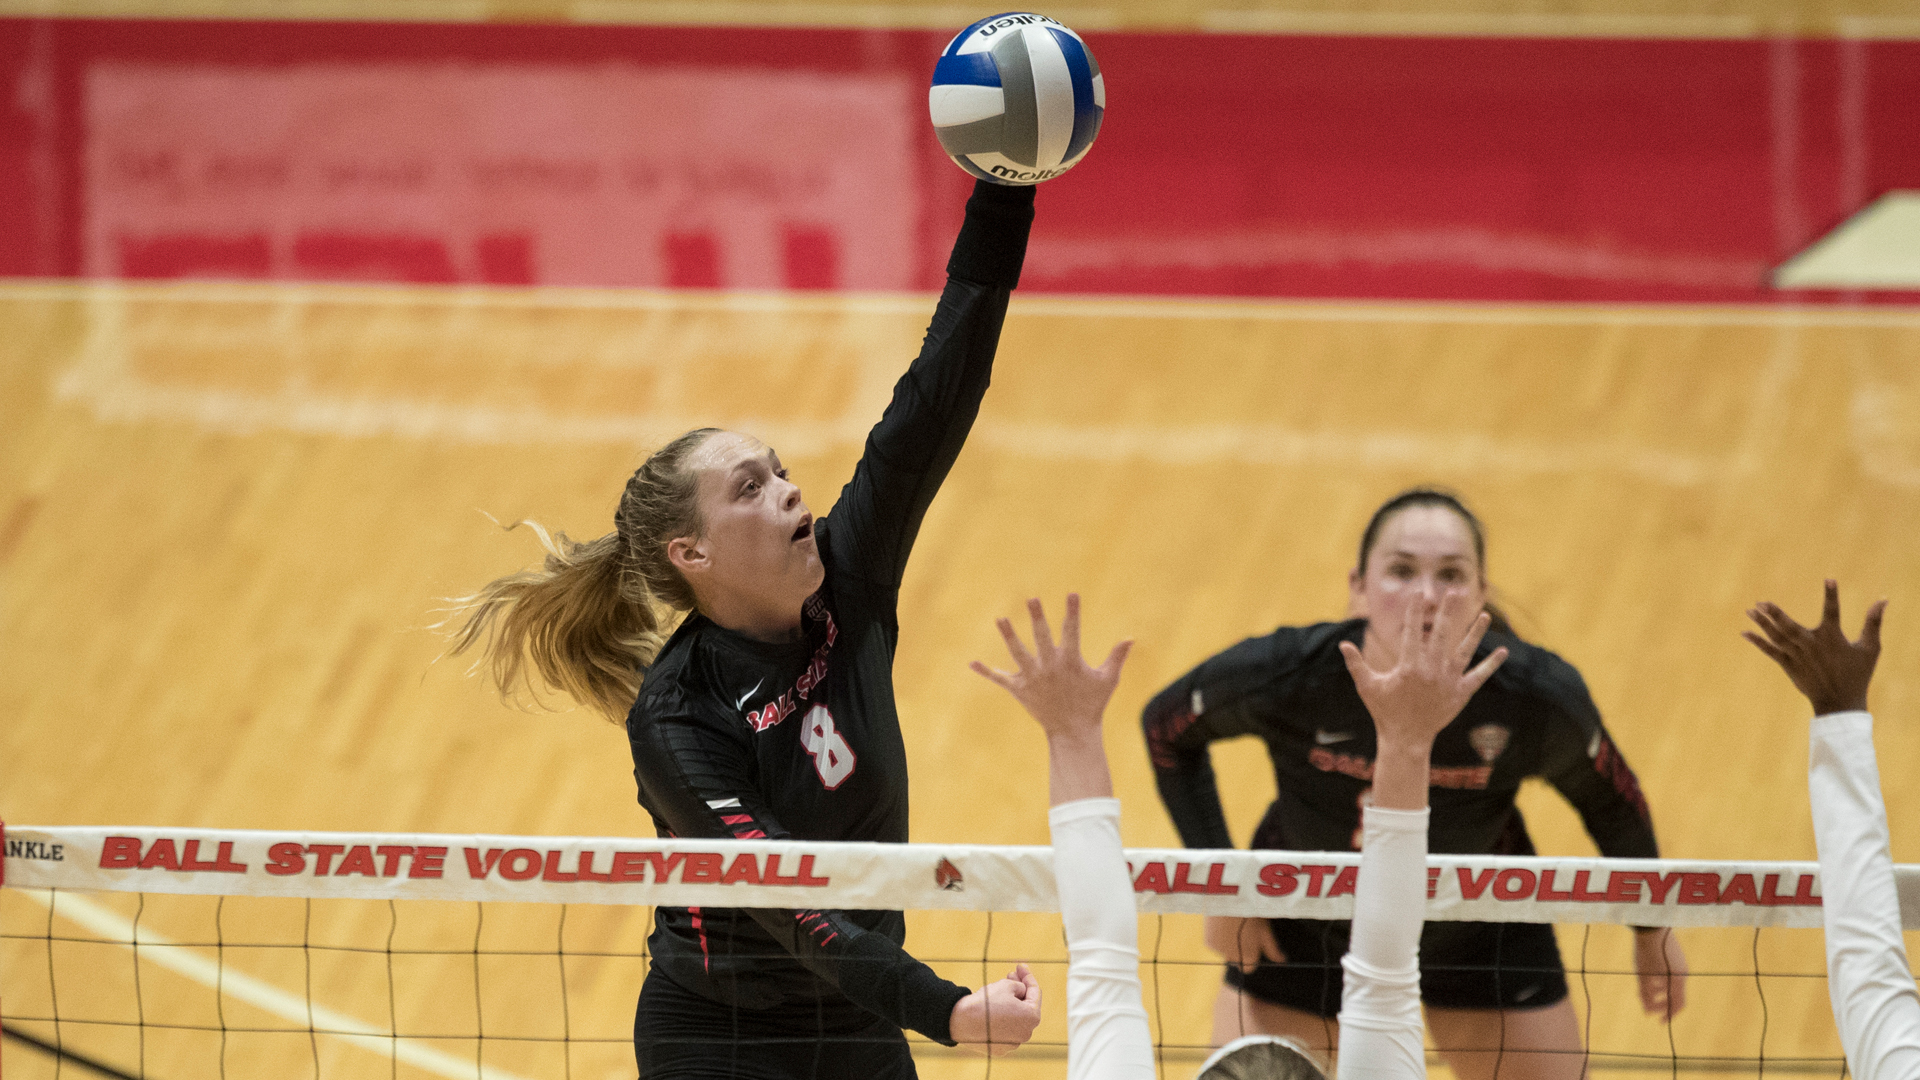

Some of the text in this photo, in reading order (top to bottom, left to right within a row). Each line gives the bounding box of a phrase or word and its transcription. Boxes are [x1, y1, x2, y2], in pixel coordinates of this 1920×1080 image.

[746, 687, 797, 733] BALL
[796, 610, 839, 700] STAE
[800, 702, 857, 791] 8
[99, 836, 830, 887] BALL STATE VOLLEYBALL
[1127, 861, 1823, 907] ALL STA VOLLEYBALL
